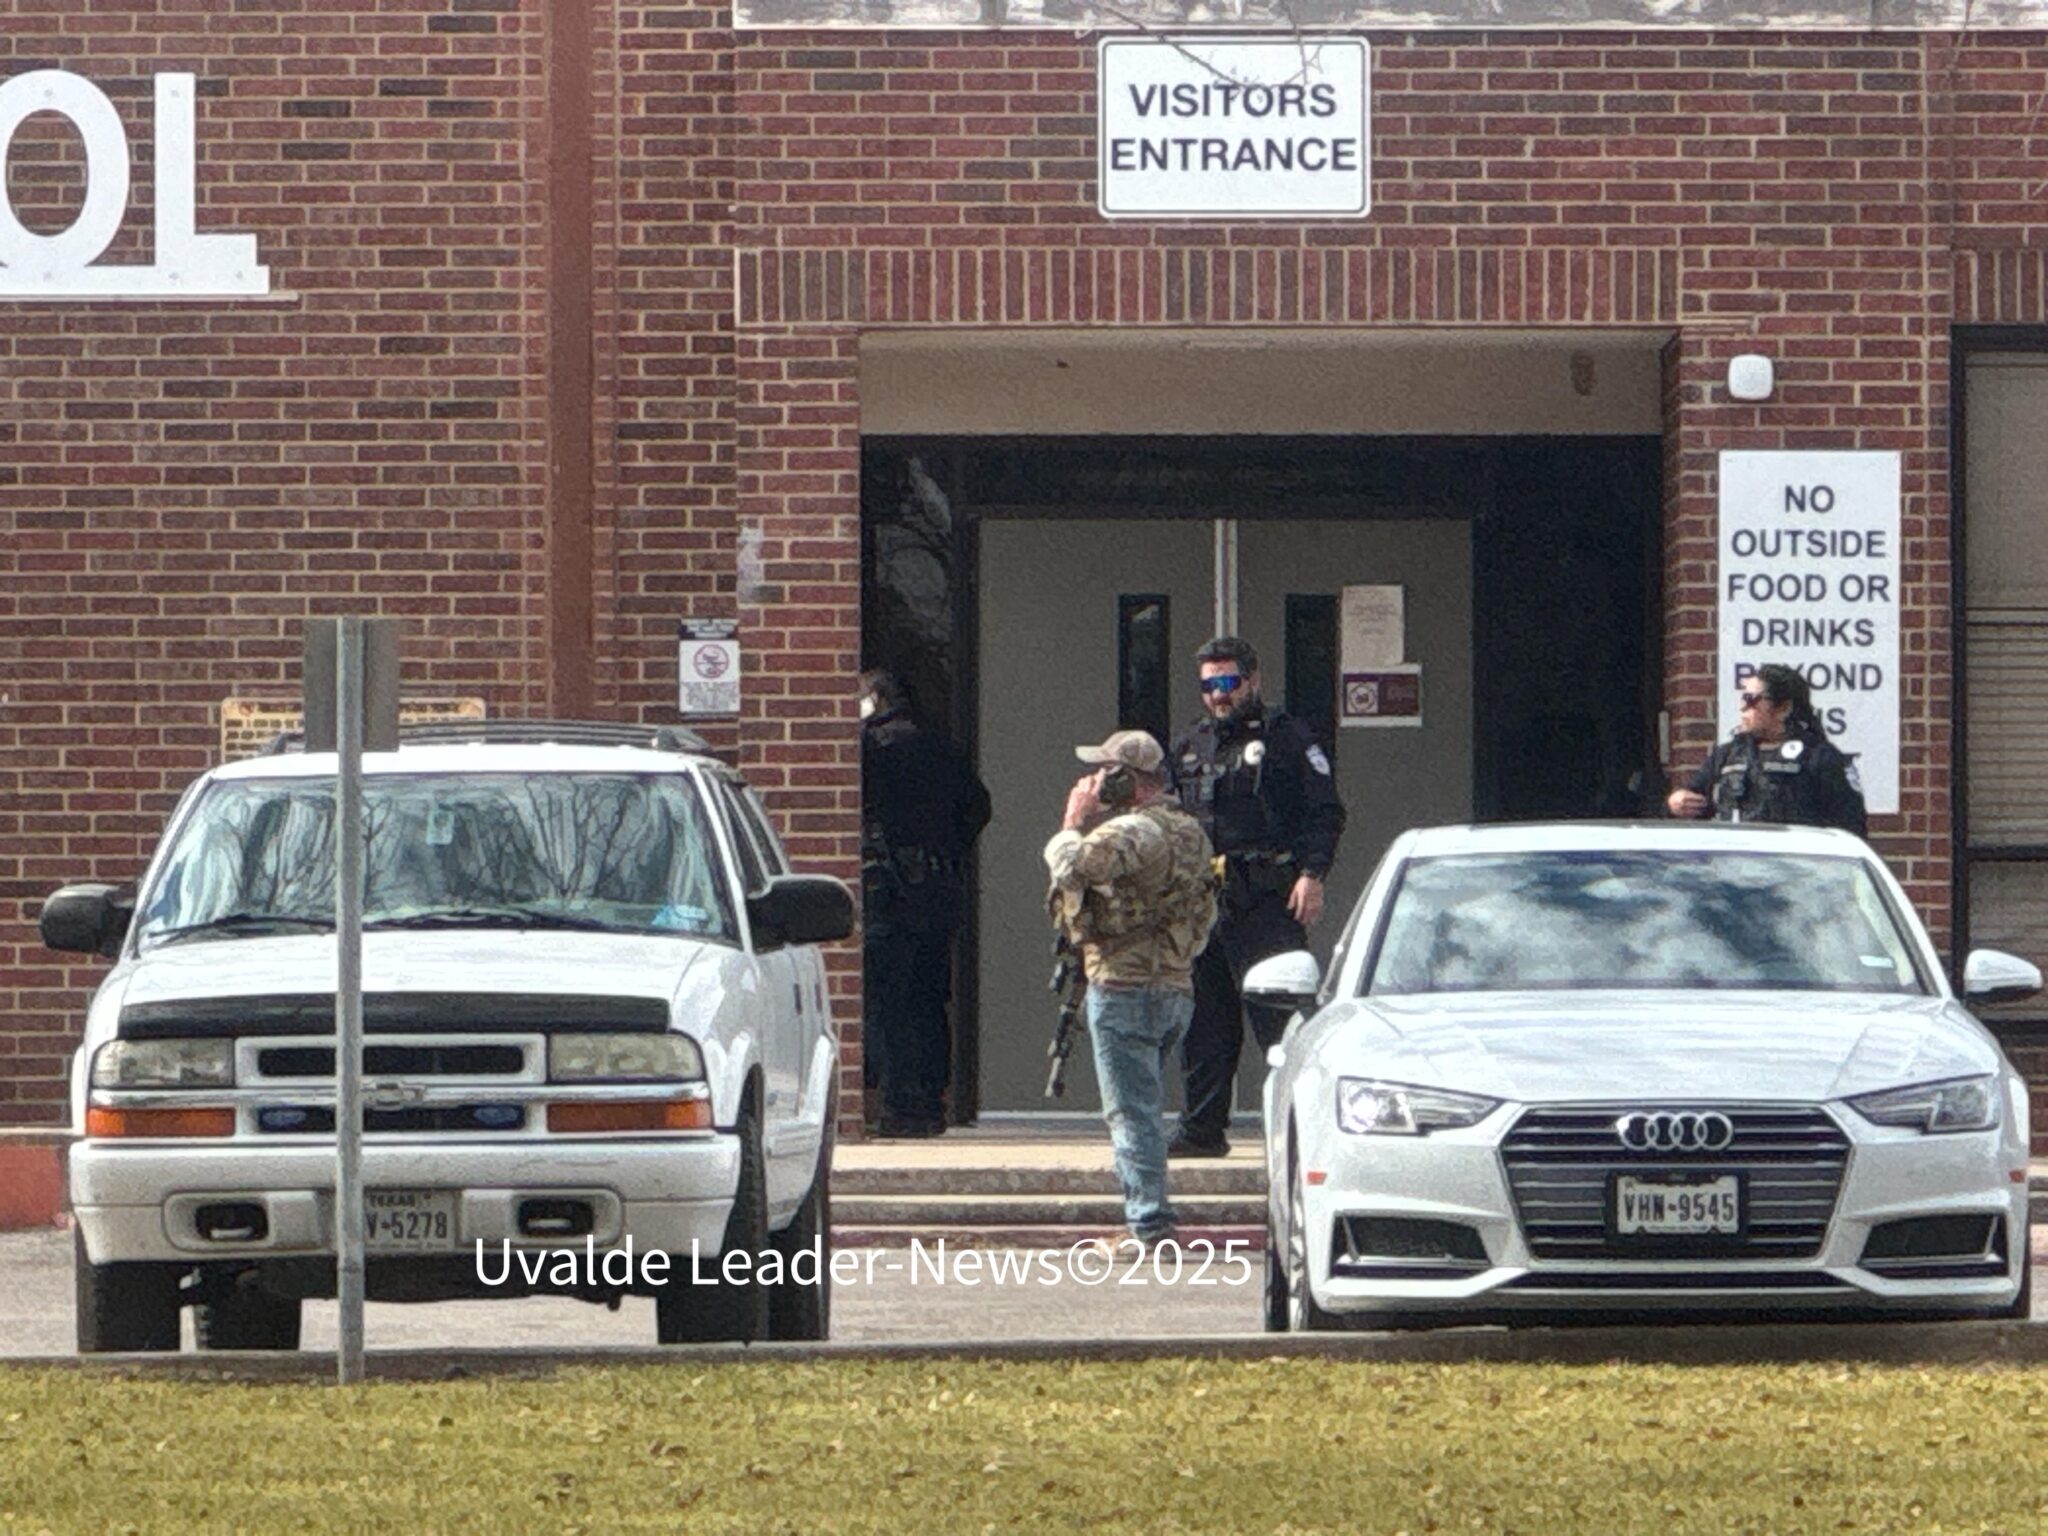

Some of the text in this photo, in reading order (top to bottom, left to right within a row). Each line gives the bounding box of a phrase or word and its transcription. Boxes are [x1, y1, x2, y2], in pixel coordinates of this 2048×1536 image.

[1129, 83, 1336, 117] VISITORS
[1111, 138, 1357, 171] ENTRANCE
[1784, 485, 1836, 513] NO
[1731, 529, 1886, 557] OUTSIDE
[1728, 573, 1891, 602] FOOD OR
[1742, 618, 1875, 647] DRINKS
[1734, 662, 1883, 691] BOND
[366, 1211, 448, 1239] V-5278
